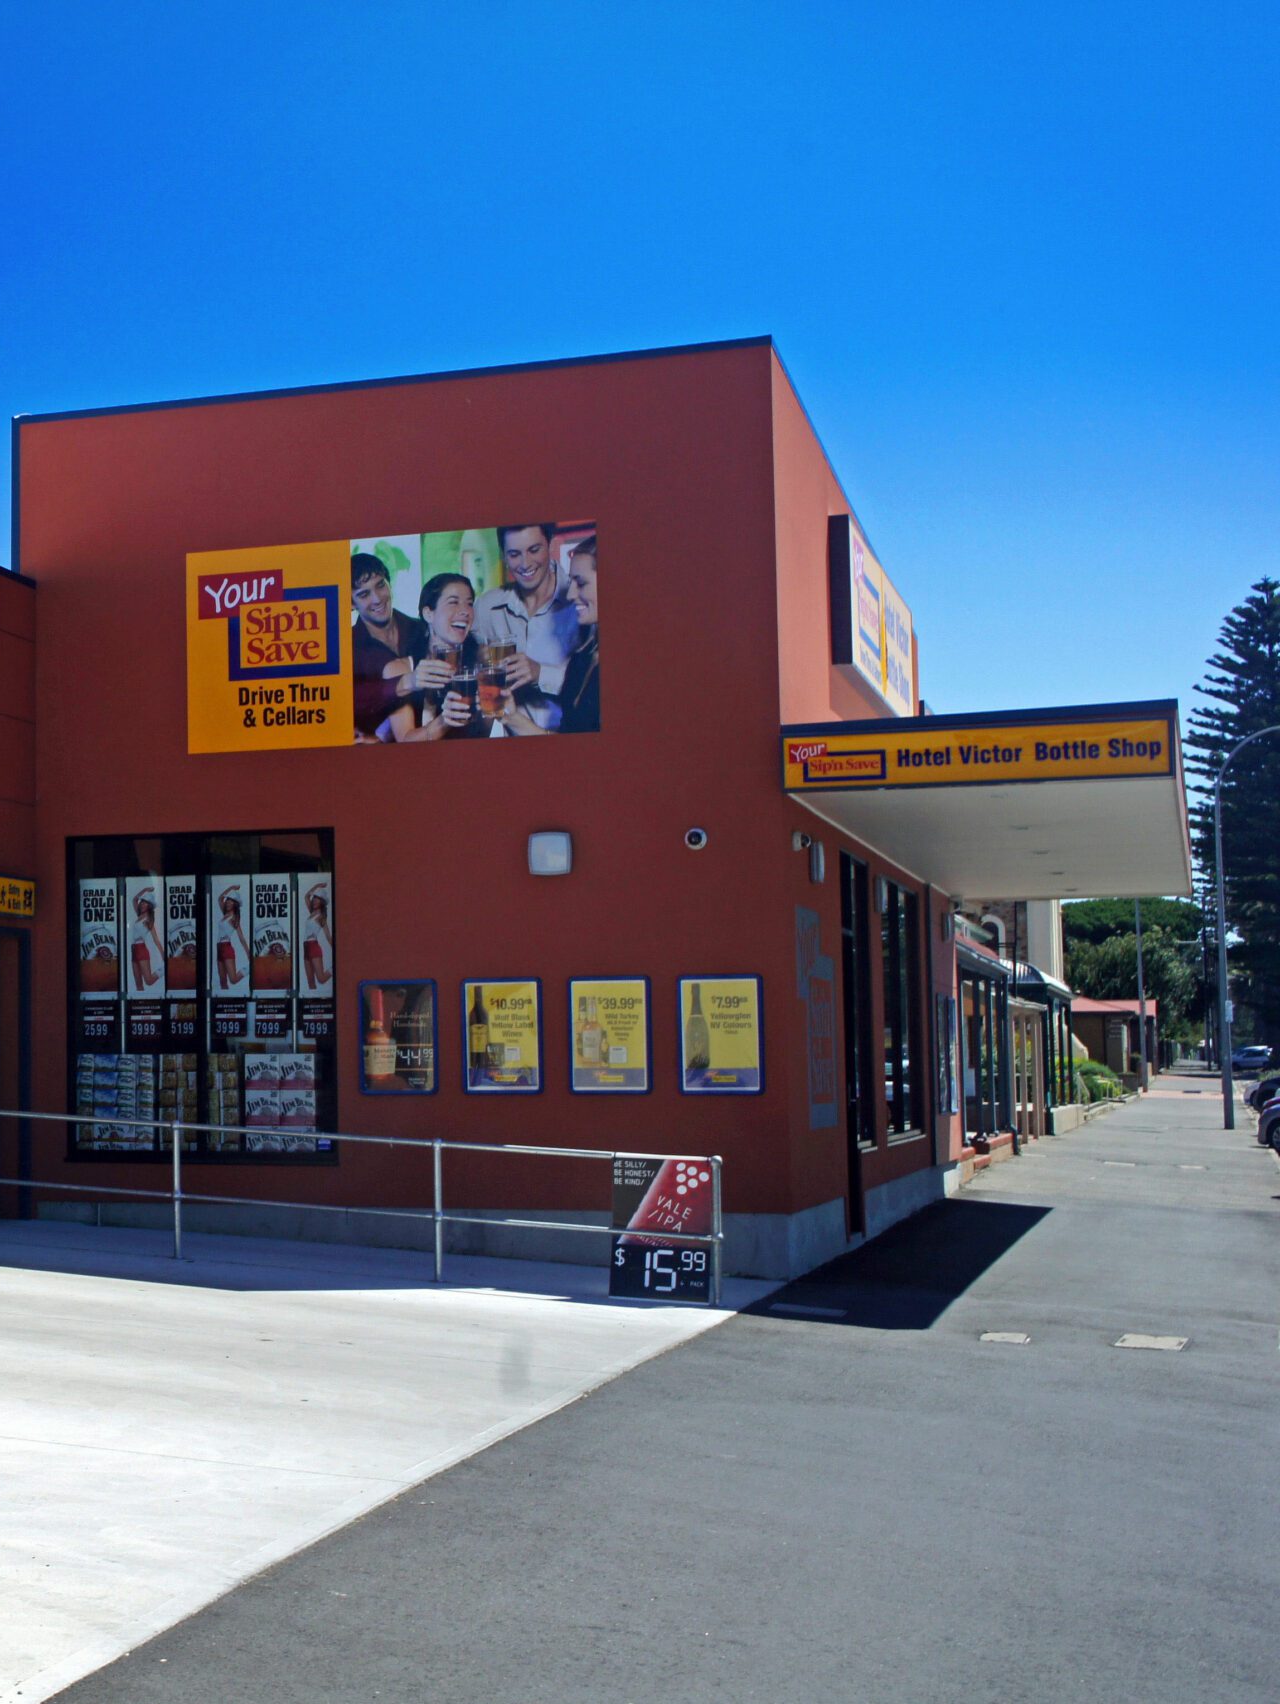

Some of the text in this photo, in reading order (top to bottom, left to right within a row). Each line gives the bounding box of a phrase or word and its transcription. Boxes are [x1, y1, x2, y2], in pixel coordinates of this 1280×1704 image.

[204, 576, 275, 614] Your
[246, 605, 320, 642] Sip'n
[246, 637, 320, 665] Save
[238, 683, 330, 706] Drive Thru
[242, 706, 326, 728] & Cellars
[790, 743, 826, 763] Your
[897, 738, 1162, 767] Hotel Victor Bottle Shop
[809, 758, 881, 775] Sip'n Save
[83, 889, 114, 897] GRAB A
[169, 886, 192, 894] GRAB
[256, 884, 287, 893] GRAB A
[256, 892, 287, 903] COLD
[83, 897, 115, 908] COLD
[256, 904, 288, 918] ONE
[83, 909, 115, 922] ONE
[657, 1195, 692, 1220] VALE
[614, 1247, 625, 1267] $
